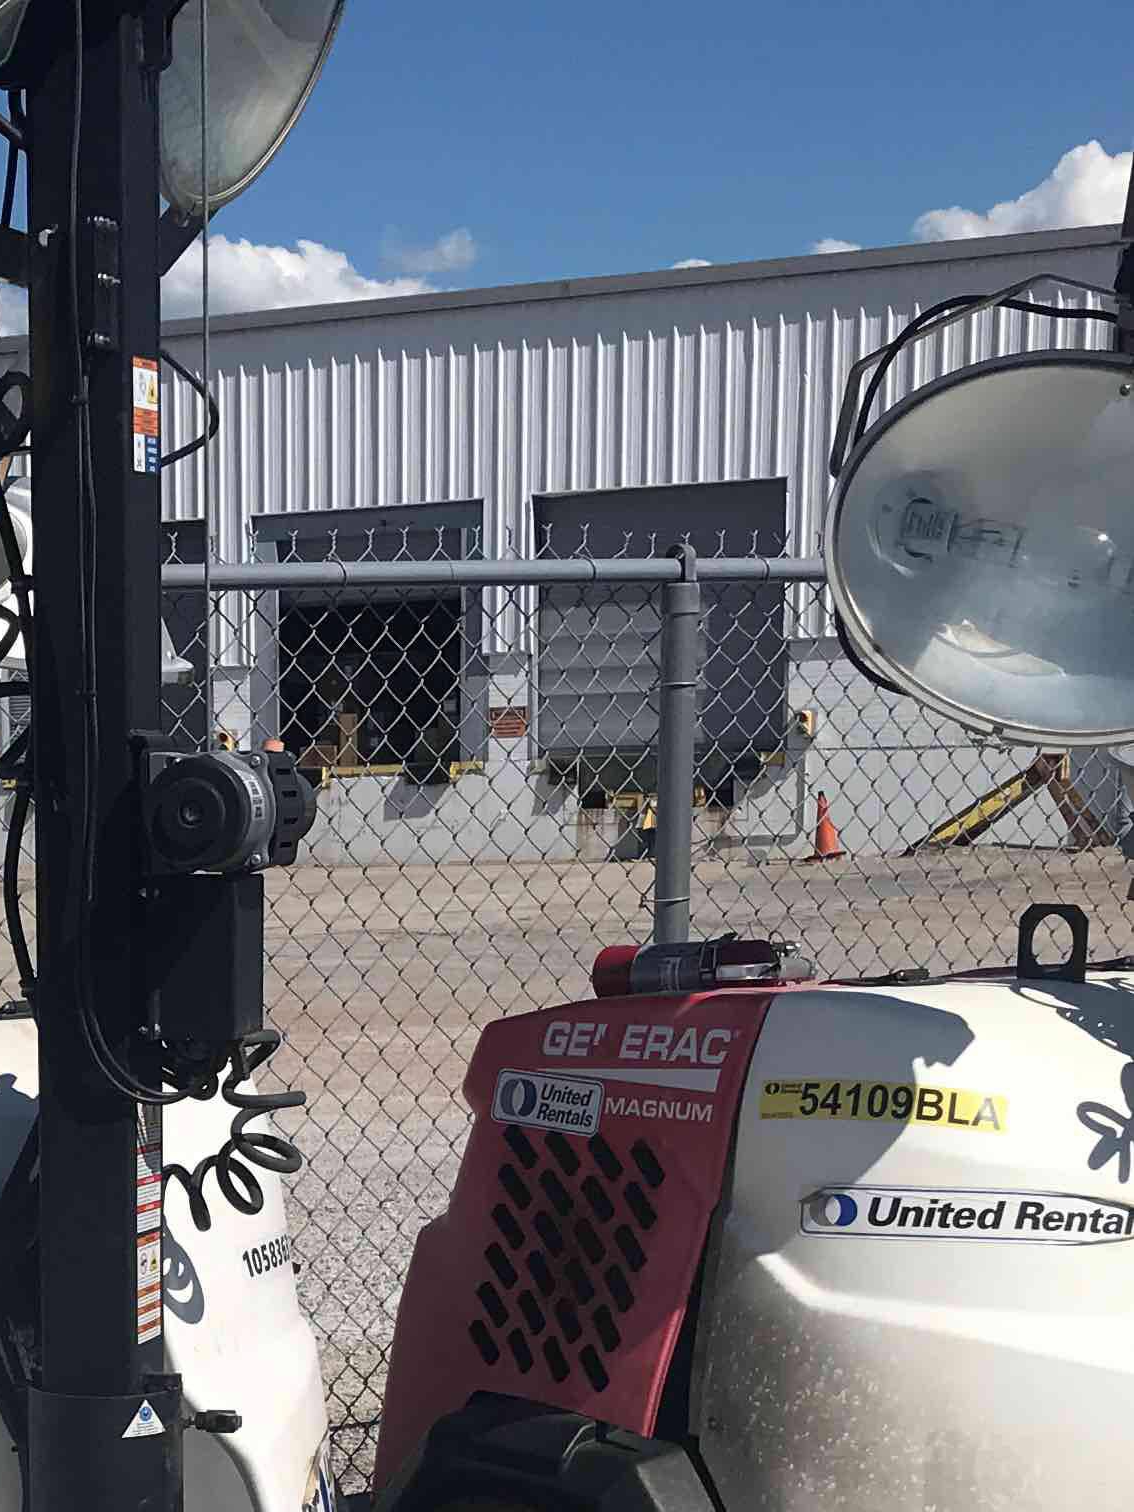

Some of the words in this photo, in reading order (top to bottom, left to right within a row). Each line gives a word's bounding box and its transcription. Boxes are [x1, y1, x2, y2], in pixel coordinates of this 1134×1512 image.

[540, 1082, 593, 1107] United
[798, 1082, 1001, 1132] 54109BLA
[536, 1103, 594, 1128] Rentals
[604, 1096, 714, 1123] MAGNUM
[867, 1196, 1008, 1231] United
